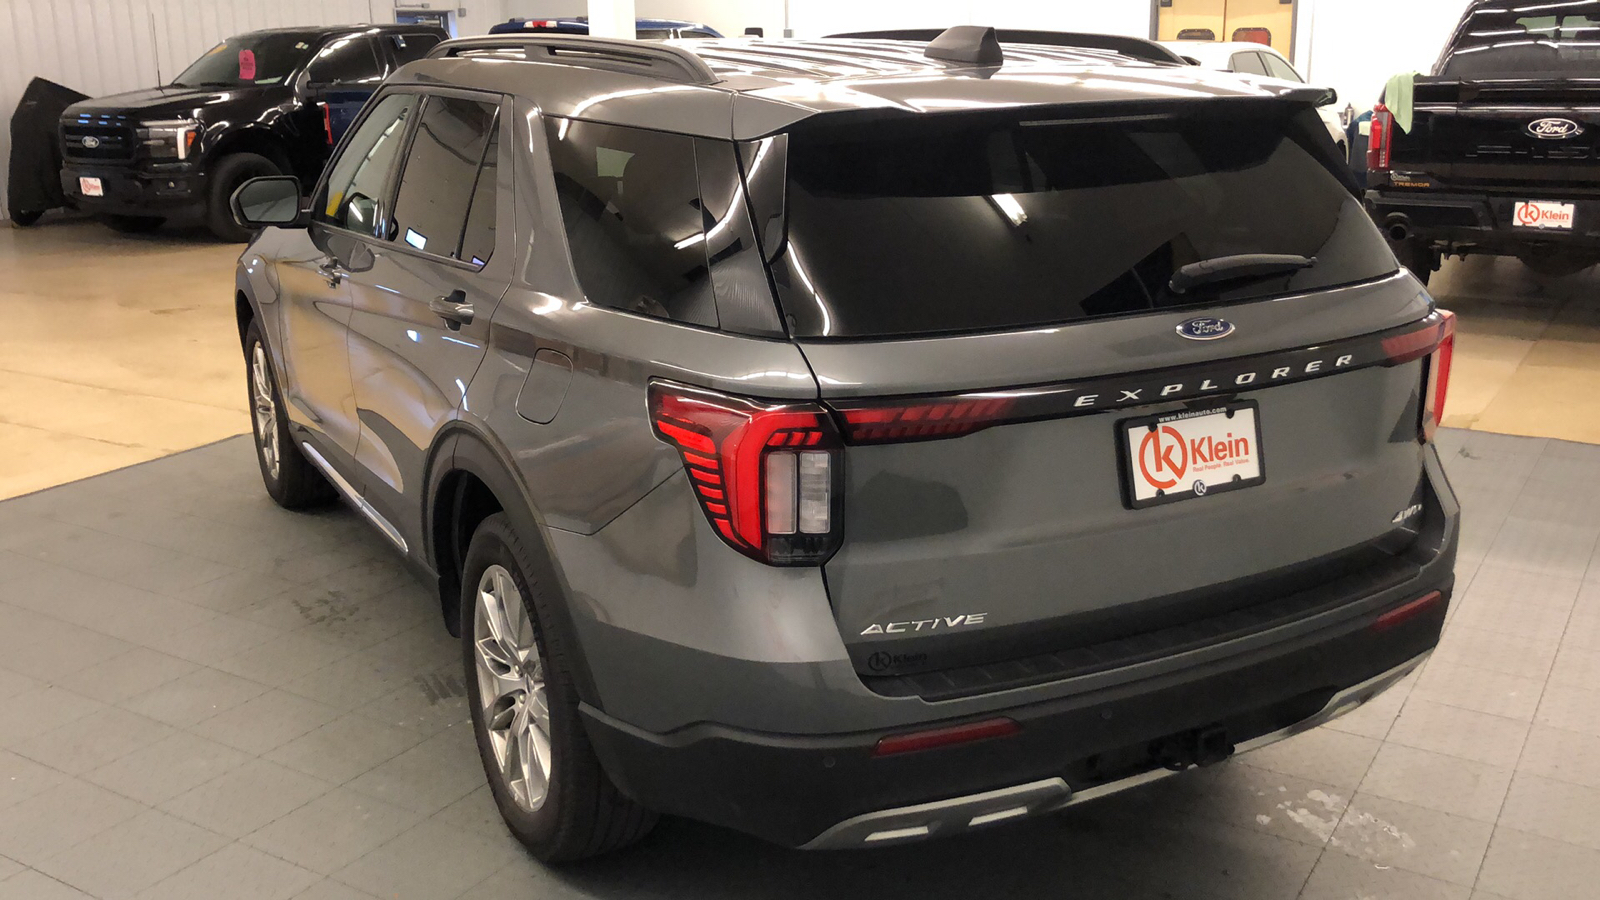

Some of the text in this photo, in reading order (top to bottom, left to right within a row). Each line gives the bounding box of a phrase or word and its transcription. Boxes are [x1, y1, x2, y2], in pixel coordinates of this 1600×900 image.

[1535, 120, 1569, 134] Ford
[1541, 209, 1569, 220] Klein
[1191, 319, 1224, 335] Ford
[1073, 354, 1353, 408] EXPLORER
[1158, 406, 1228, 423] www.kleinauto.com
[1190, 432, 1249, 465] Klein
[1192, 465, 1204, 473] Real
[860, 612, 988, 636] ACTIVE
[893, 652, 928, 664] Klein
